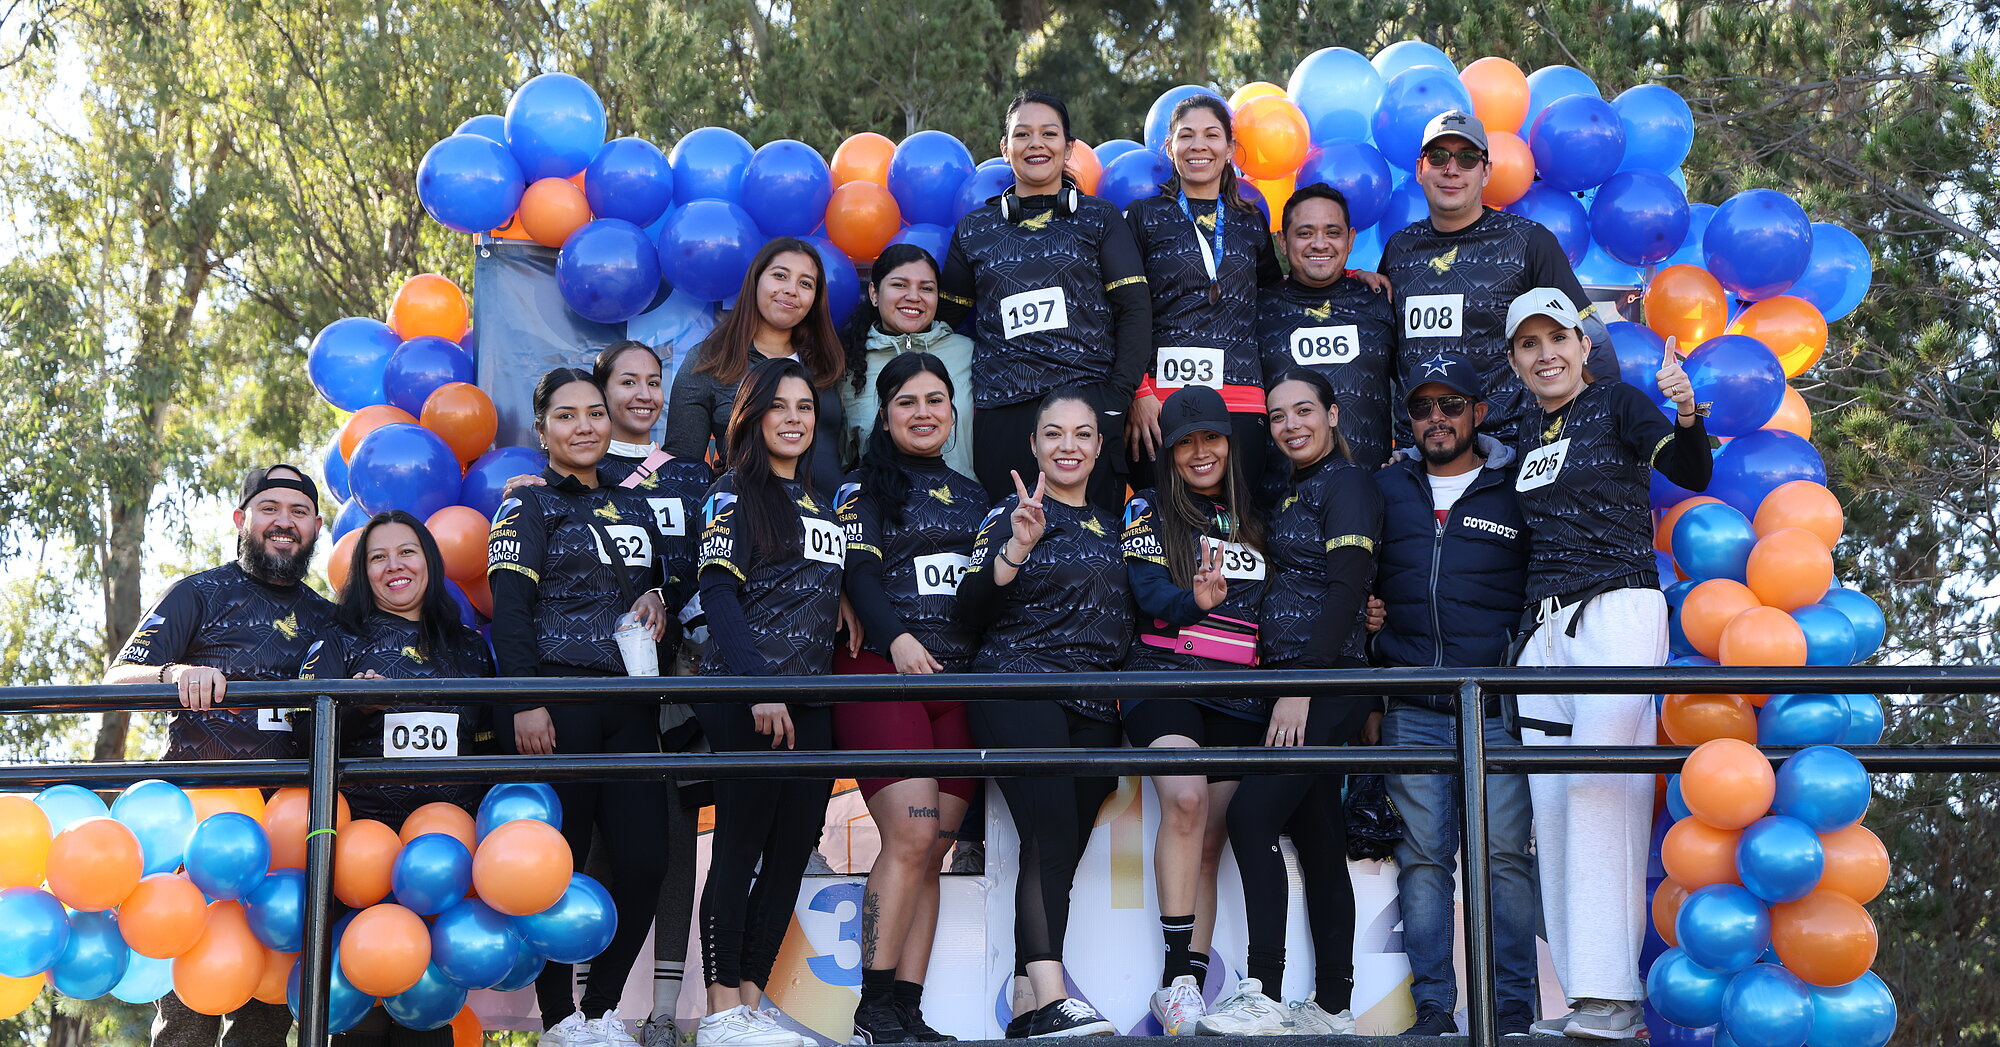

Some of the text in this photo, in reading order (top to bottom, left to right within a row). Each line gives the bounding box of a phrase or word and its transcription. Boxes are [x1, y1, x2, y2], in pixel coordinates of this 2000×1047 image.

[1008, 299, 1055, 330] 197
[1409, 306, 1453, 330] 008
[1298, 335, 1350, 358] 086
[1163, 358, 1214, 382] 093
[1522, 452, 1560, 480] 205
[1462, 516, 1519, 539] COWBOYS
[613, 536, 646, 558] 62
[811, 528, 844, 559] 011
[1120, 534, 1161, 552] EON
[391, 725, 448, 751] 030
[806, 883, 866, 986] 3
